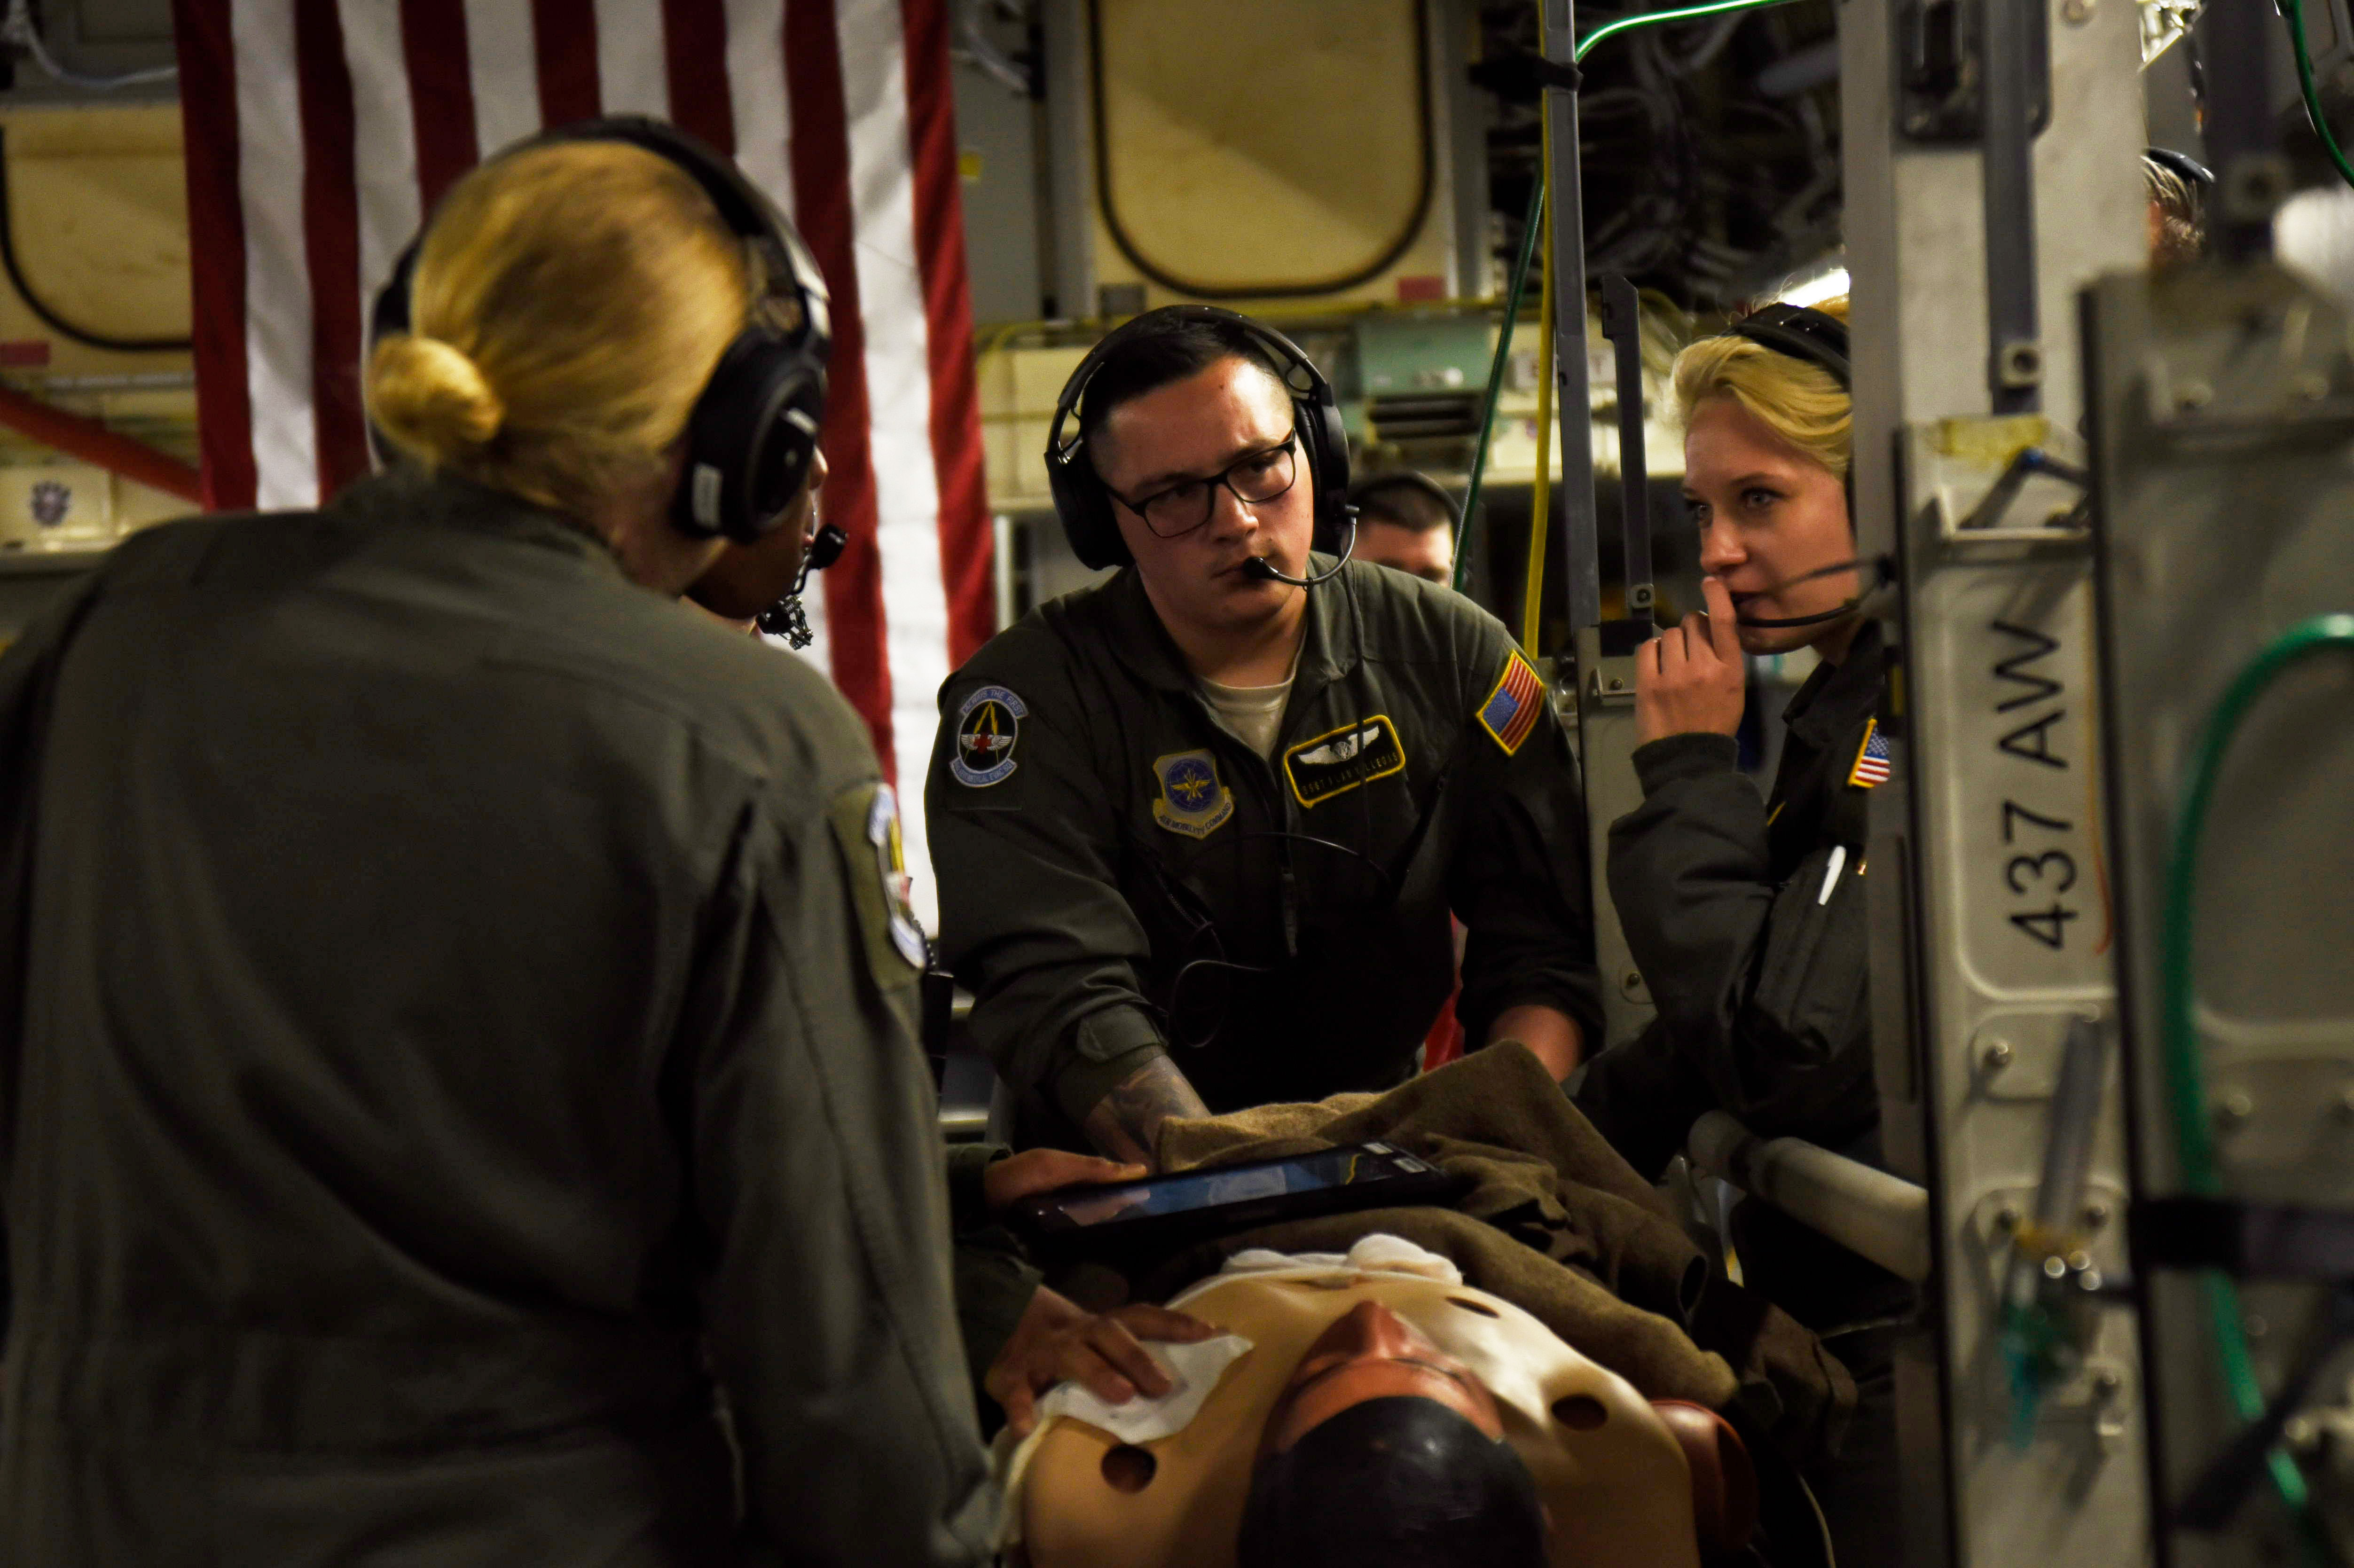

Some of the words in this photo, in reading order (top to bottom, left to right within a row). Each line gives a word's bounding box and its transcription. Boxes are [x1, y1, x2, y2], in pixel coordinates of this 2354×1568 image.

[991, 689, 1005, 699] THE
[1007, 696, 1024, 716] FIRST
[1991, 620, 2068, 769] AW
[2004, 800, 2078, 949] 437
